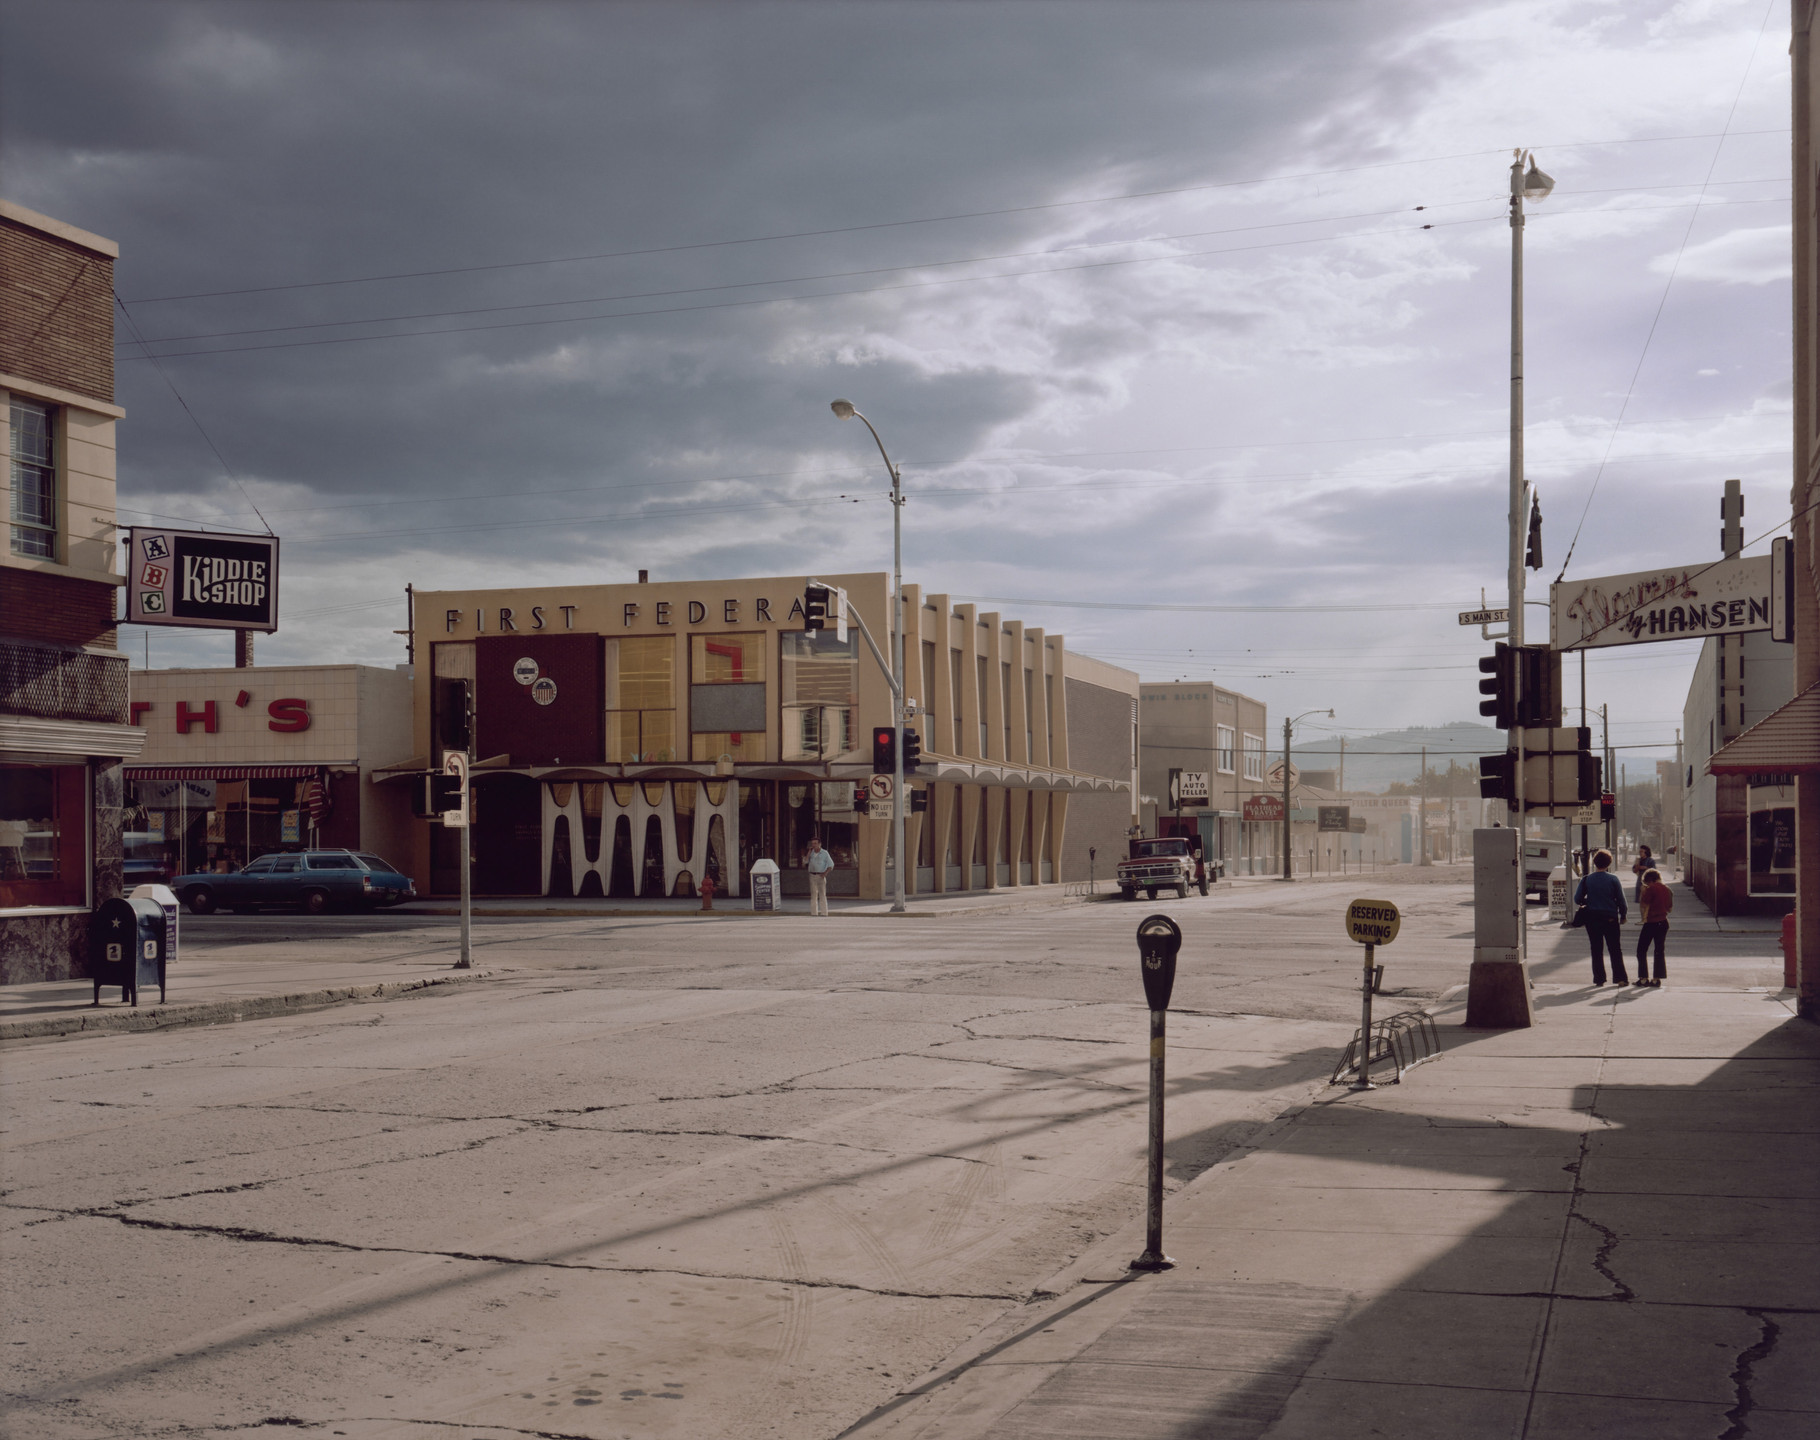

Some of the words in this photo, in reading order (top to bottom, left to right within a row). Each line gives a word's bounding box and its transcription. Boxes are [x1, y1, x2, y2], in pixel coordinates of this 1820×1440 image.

[149, 539, 165, 557] A
[146, 567, 162, 585] B
[145, 594, 161, 610] C
[211, 581, 266, 606] SHOP
[447, 605, 580, 632] FIRST
[1473, 613, 1491, 621] MAIN
[1649, 596, 1768, 635] HANSEN
[1352, 799, 1379, 807] FILTER
[1382, 799, 1409, 808] QUEEN
[1351, 906, 1396, 921] RESERVED
[1353, 923, 1391, 938] PARKING
